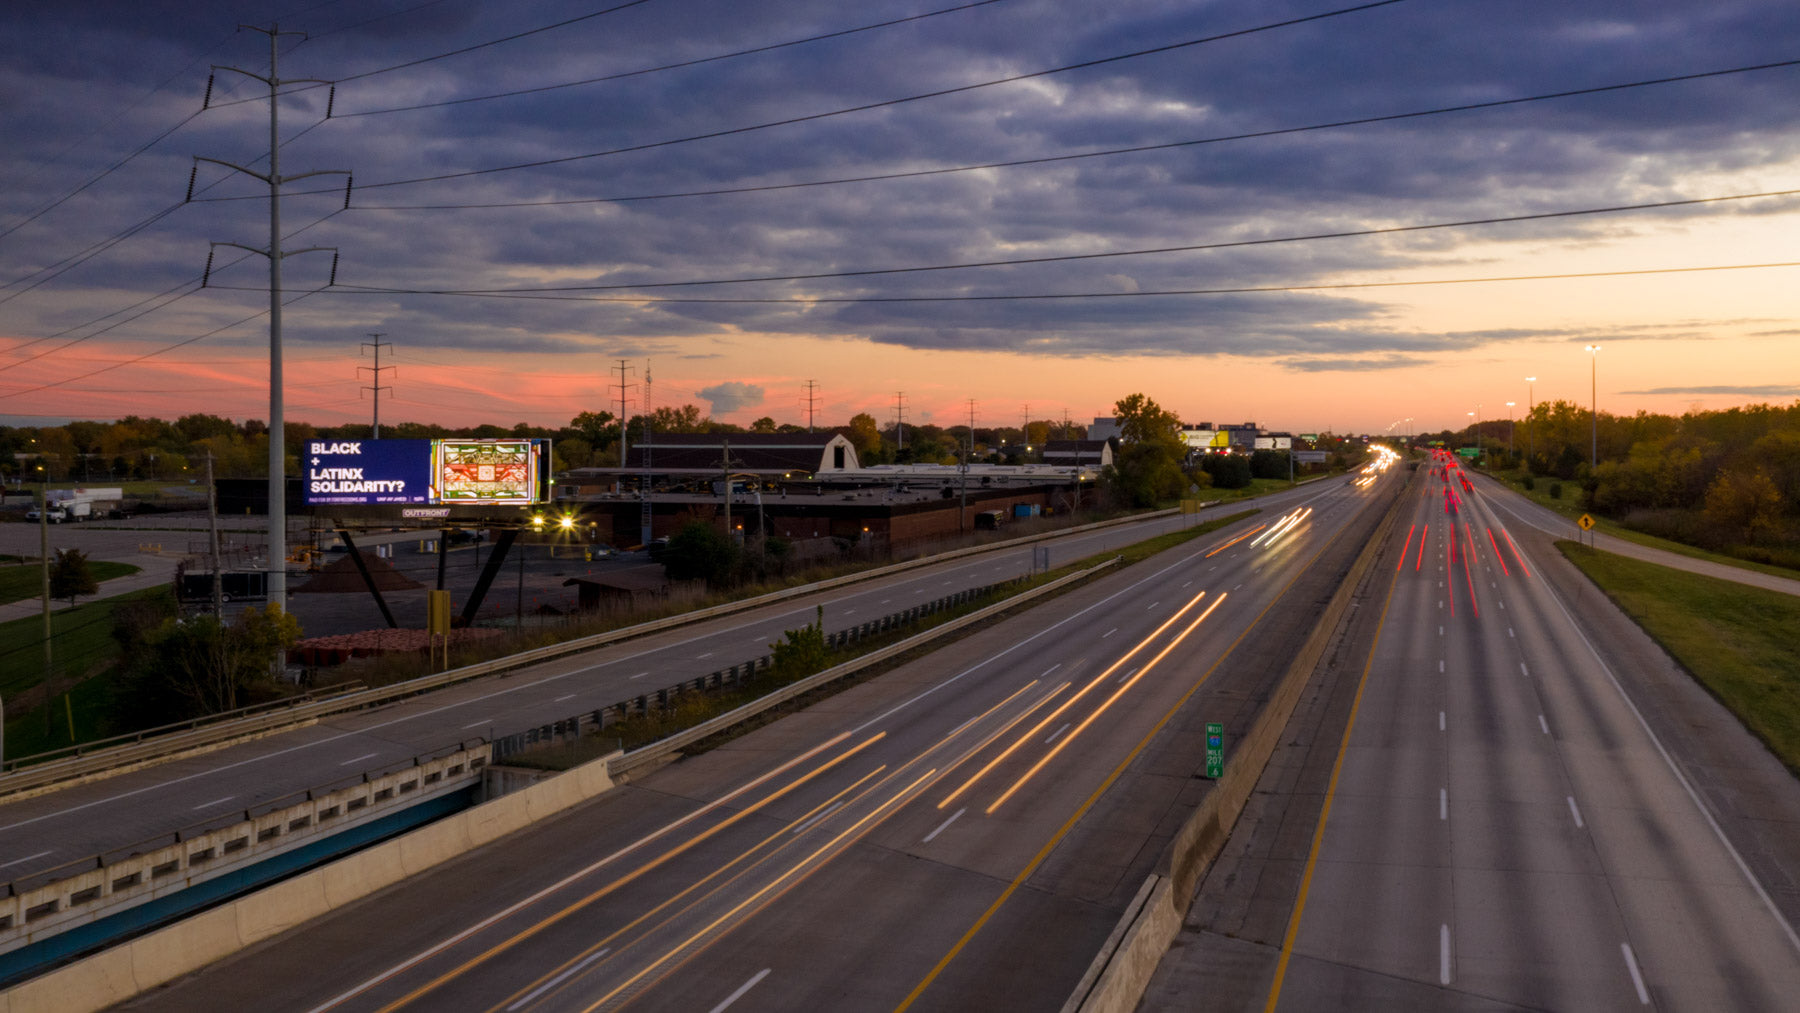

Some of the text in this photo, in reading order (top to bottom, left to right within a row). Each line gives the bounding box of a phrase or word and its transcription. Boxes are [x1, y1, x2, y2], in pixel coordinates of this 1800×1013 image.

[311, 443, 361, 454] BLACK
[311, 457, 320, 466] +
[311, 468, 363, 479] LATINX
[311, 481, 405, 492] SOLIDARITY?
[404, 508, 449, 518] OUTFRONT
[1207, 756, 1222, 765] 207
